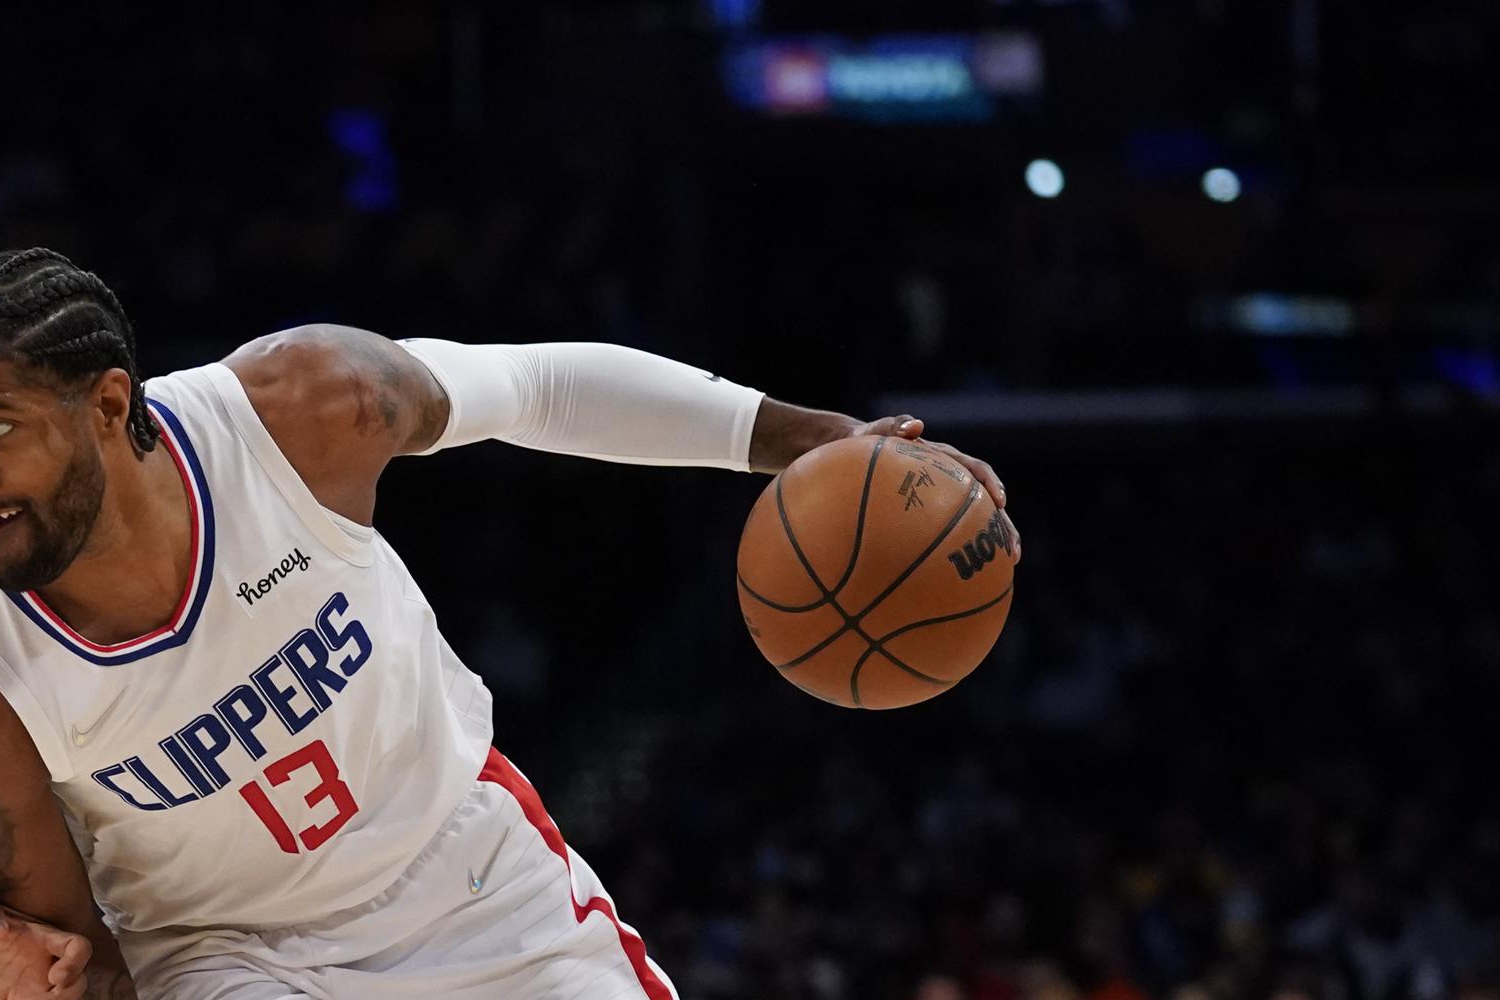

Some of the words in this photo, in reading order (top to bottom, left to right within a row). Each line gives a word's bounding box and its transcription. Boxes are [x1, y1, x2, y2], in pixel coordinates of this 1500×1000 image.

[236, 547, 311, 605] honey
[91, 591, 373, 812] CLIPPERS
[238, 739, 359, 854] 13
